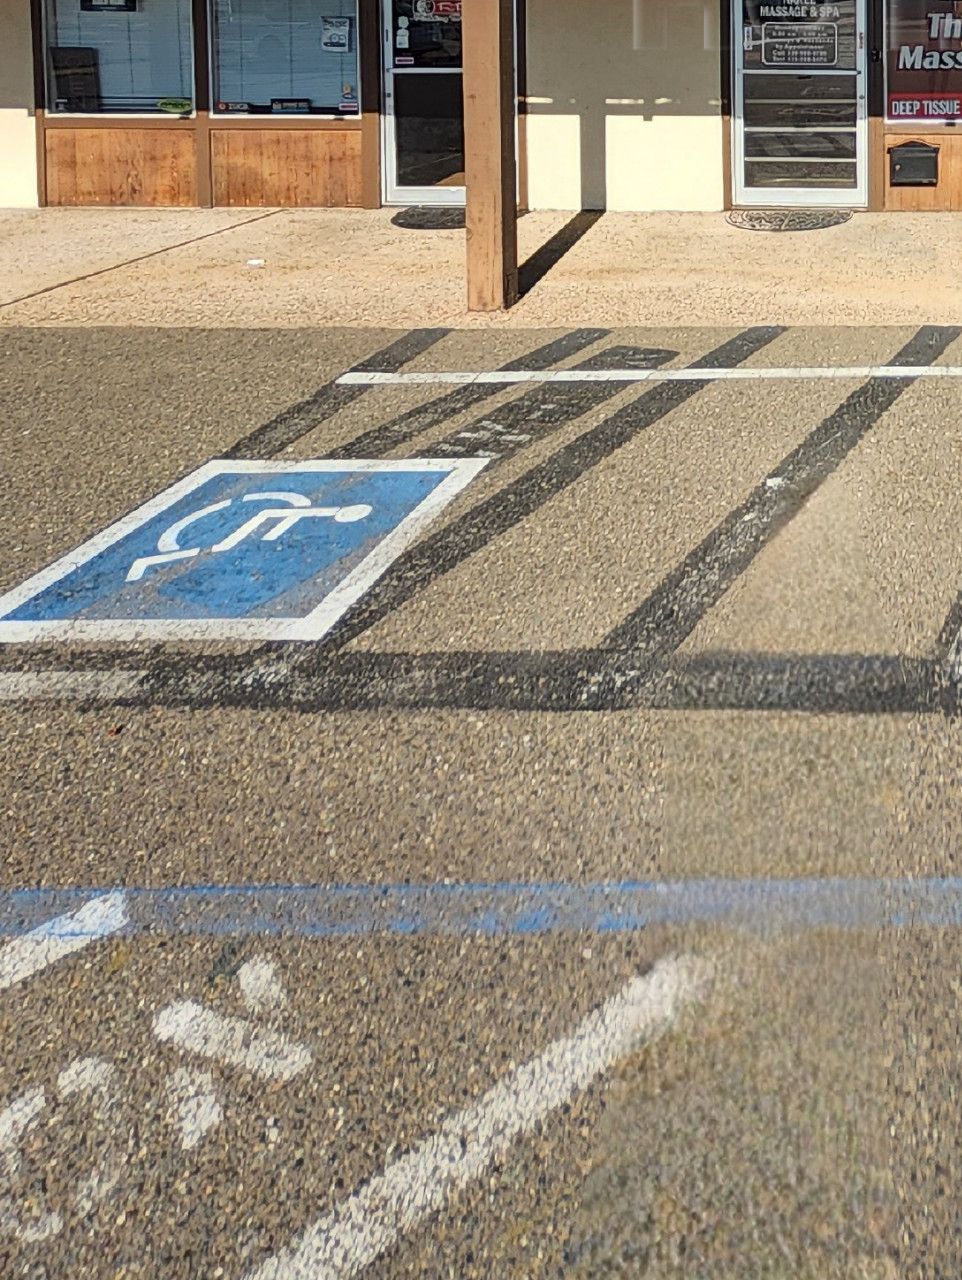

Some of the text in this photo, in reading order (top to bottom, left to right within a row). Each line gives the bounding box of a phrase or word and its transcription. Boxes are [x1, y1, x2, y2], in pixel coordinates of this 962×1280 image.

[760, 6, 839, 17] MASSAGE & SPA
[892, 101, 920, 115] DEEP
[922, 100, 960, 115] TISSUE
